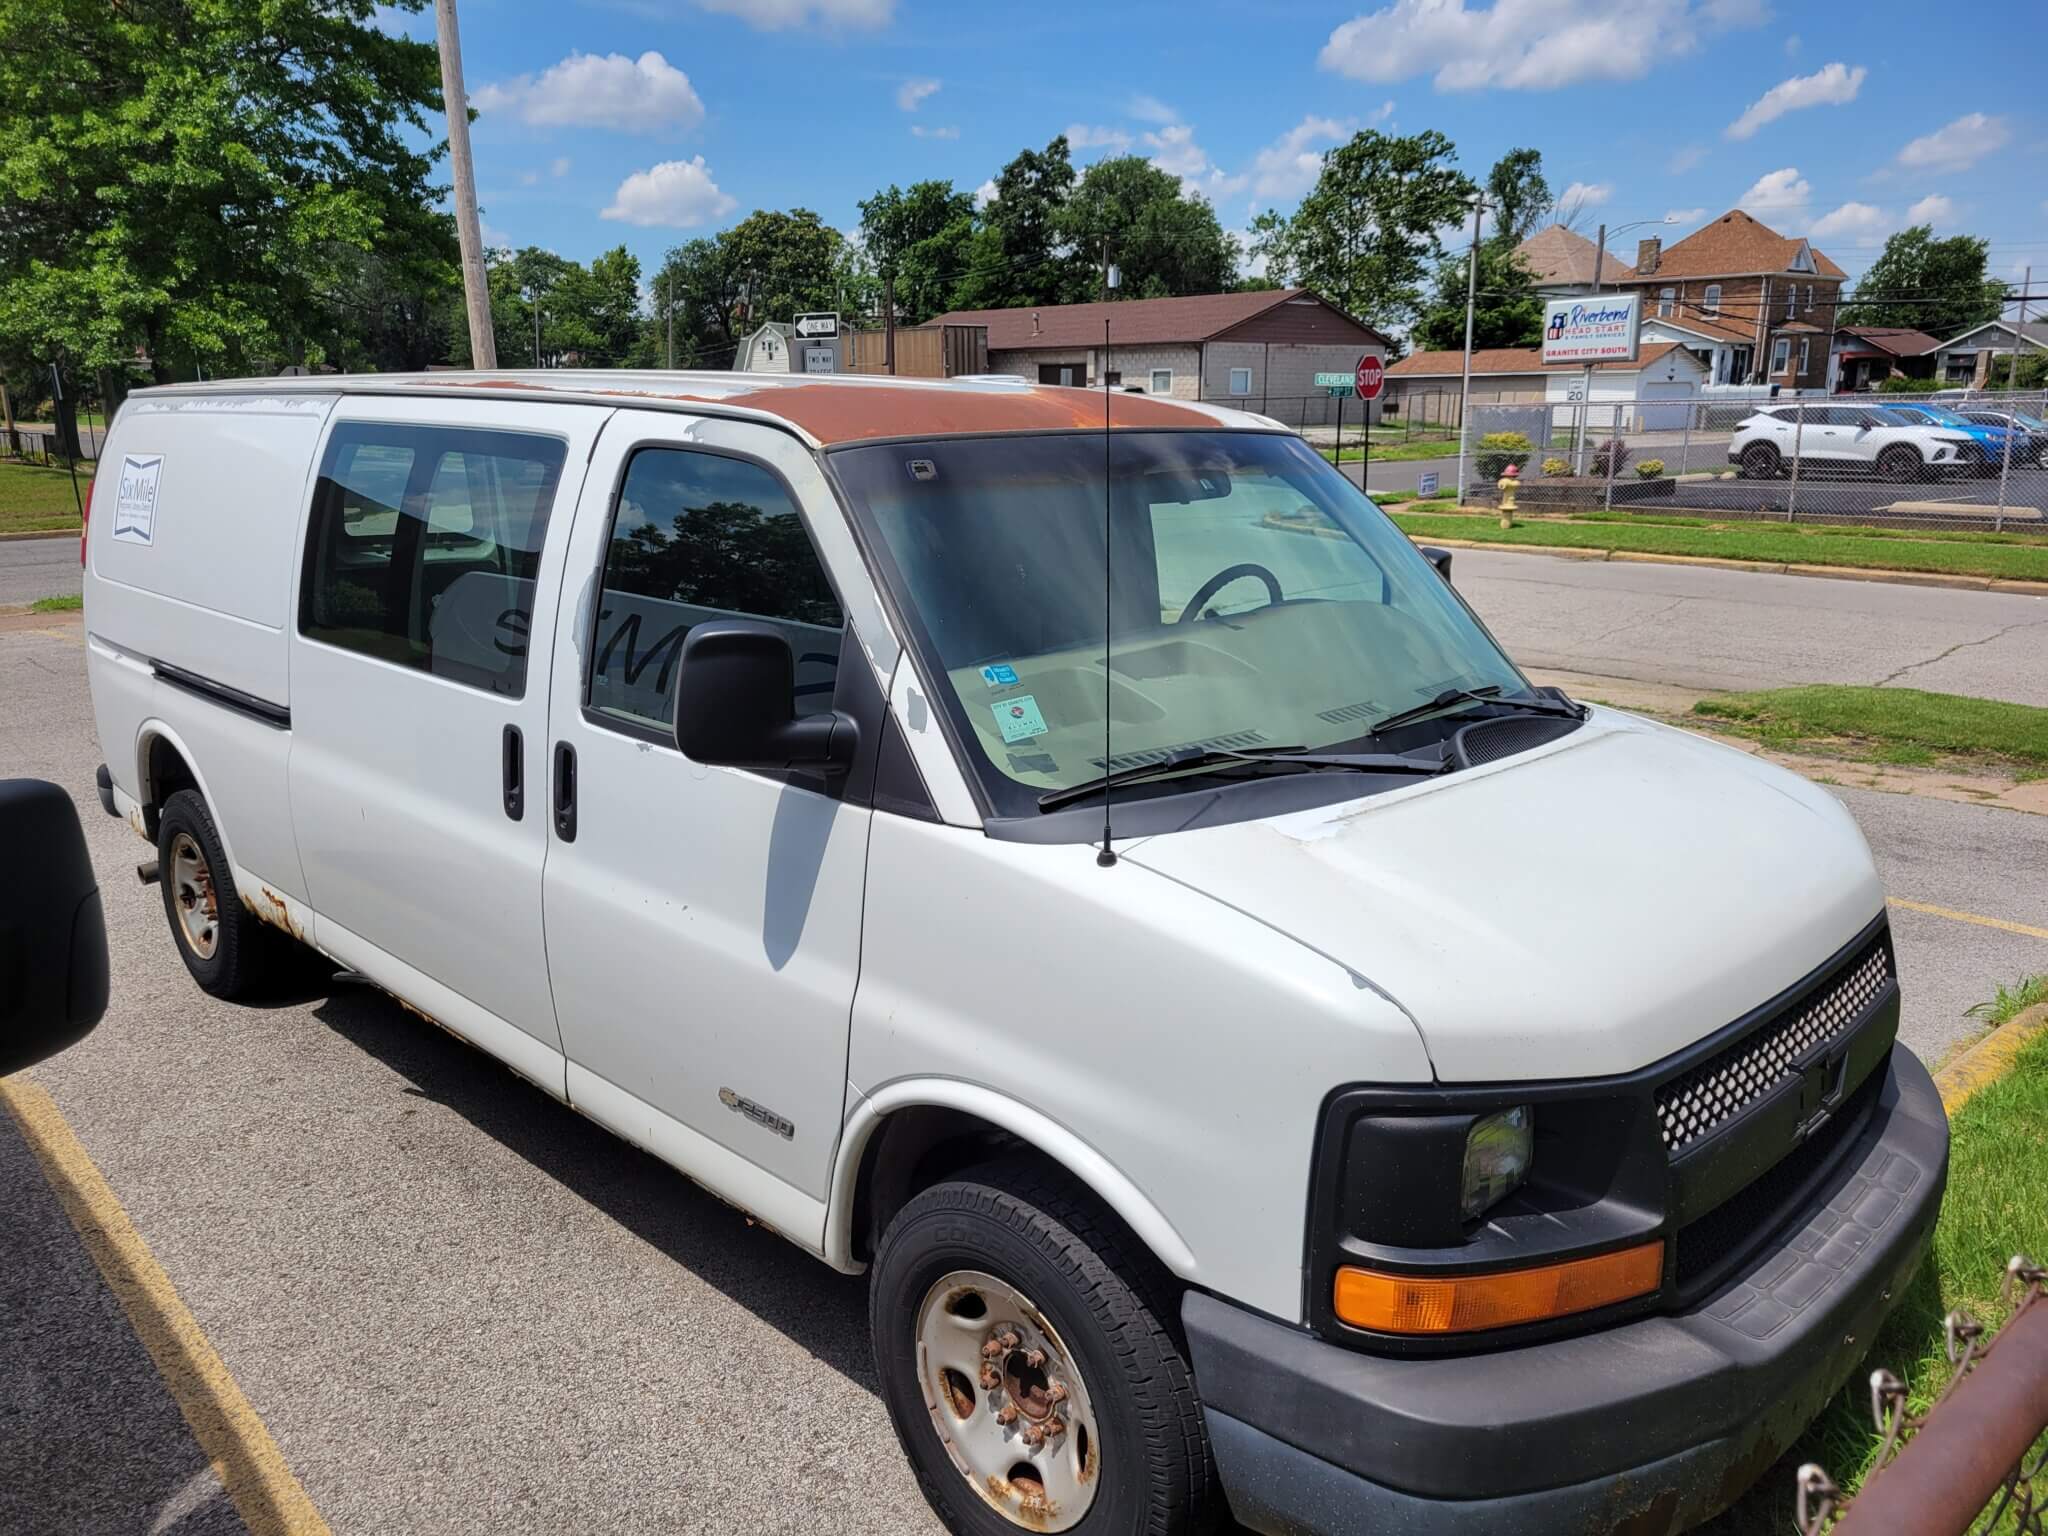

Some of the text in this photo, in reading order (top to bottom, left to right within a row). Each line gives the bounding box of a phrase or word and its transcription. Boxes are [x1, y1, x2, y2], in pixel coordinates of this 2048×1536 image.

[1571, 304, 1631, 328] Riverbend
[807, 320, 833, 330] ONE WAY
[1596, 325, 1625, 333] START
[808, 356, 820, 364] TWO
[1318, 375, 1356, 385] CLEVELAND
[1359, 369, 1381, 386] STOP
[1568, 391, 1583, 401] 20
[120, 477, 154, 503] Six Mile
